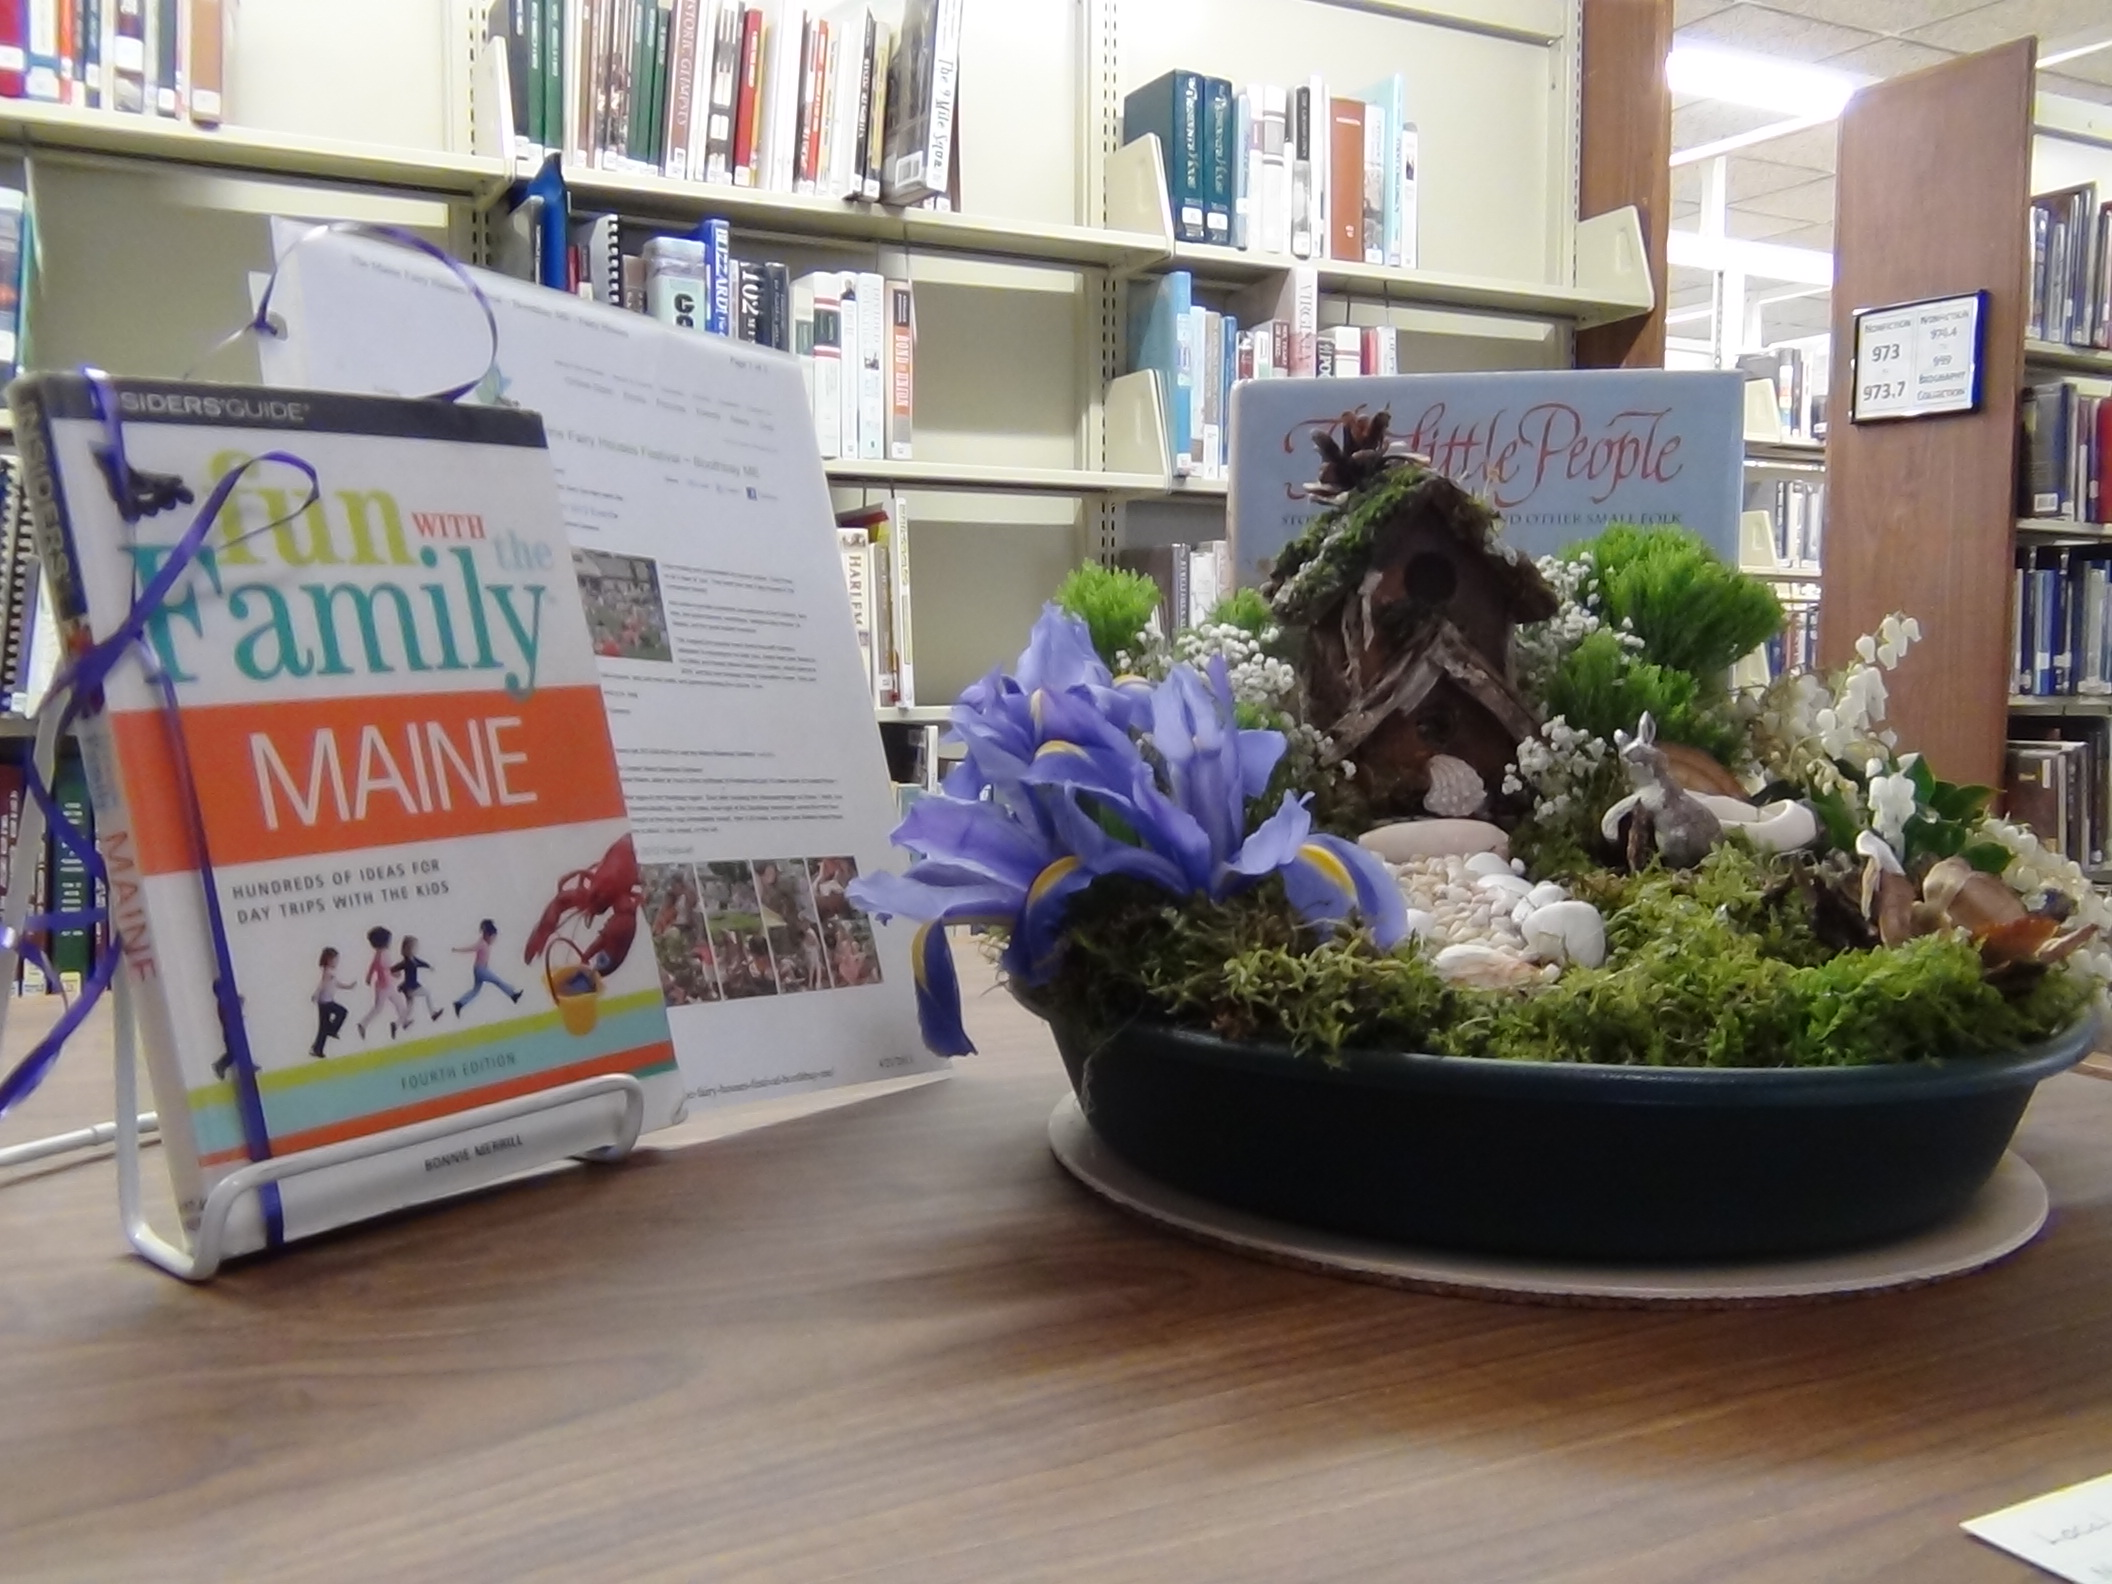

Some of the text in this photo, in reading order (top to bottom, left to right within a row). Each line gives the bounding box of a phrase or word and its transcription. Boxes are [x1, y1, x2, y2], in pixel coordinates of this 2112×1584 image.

[741, 270, 760, 316] 102
[1872, 344, 1900, 362] 973
[1863, 381, 1905, 401] 973.7
[1494, 401, 1684, 508] People
[206, 448, 418, 567] fun
[1525, 512, 1580, 526] OTHER
[1640, 511, 1682, 525] FOLK
[411, 512, 553, 571] WITH the
[119, 545, 548, 698] Family
[250, 717, 538, 831] MAINE
[232, 858, 441, 901] HUNDREDS OF IDEAS FOR
[237, 880, 450, 926] DAY TRIPS WITH THE KIDS
[400, 1051, 516, 1090] FOURTH EDITION
[424, 1147, 470, 1172] BONNIE
